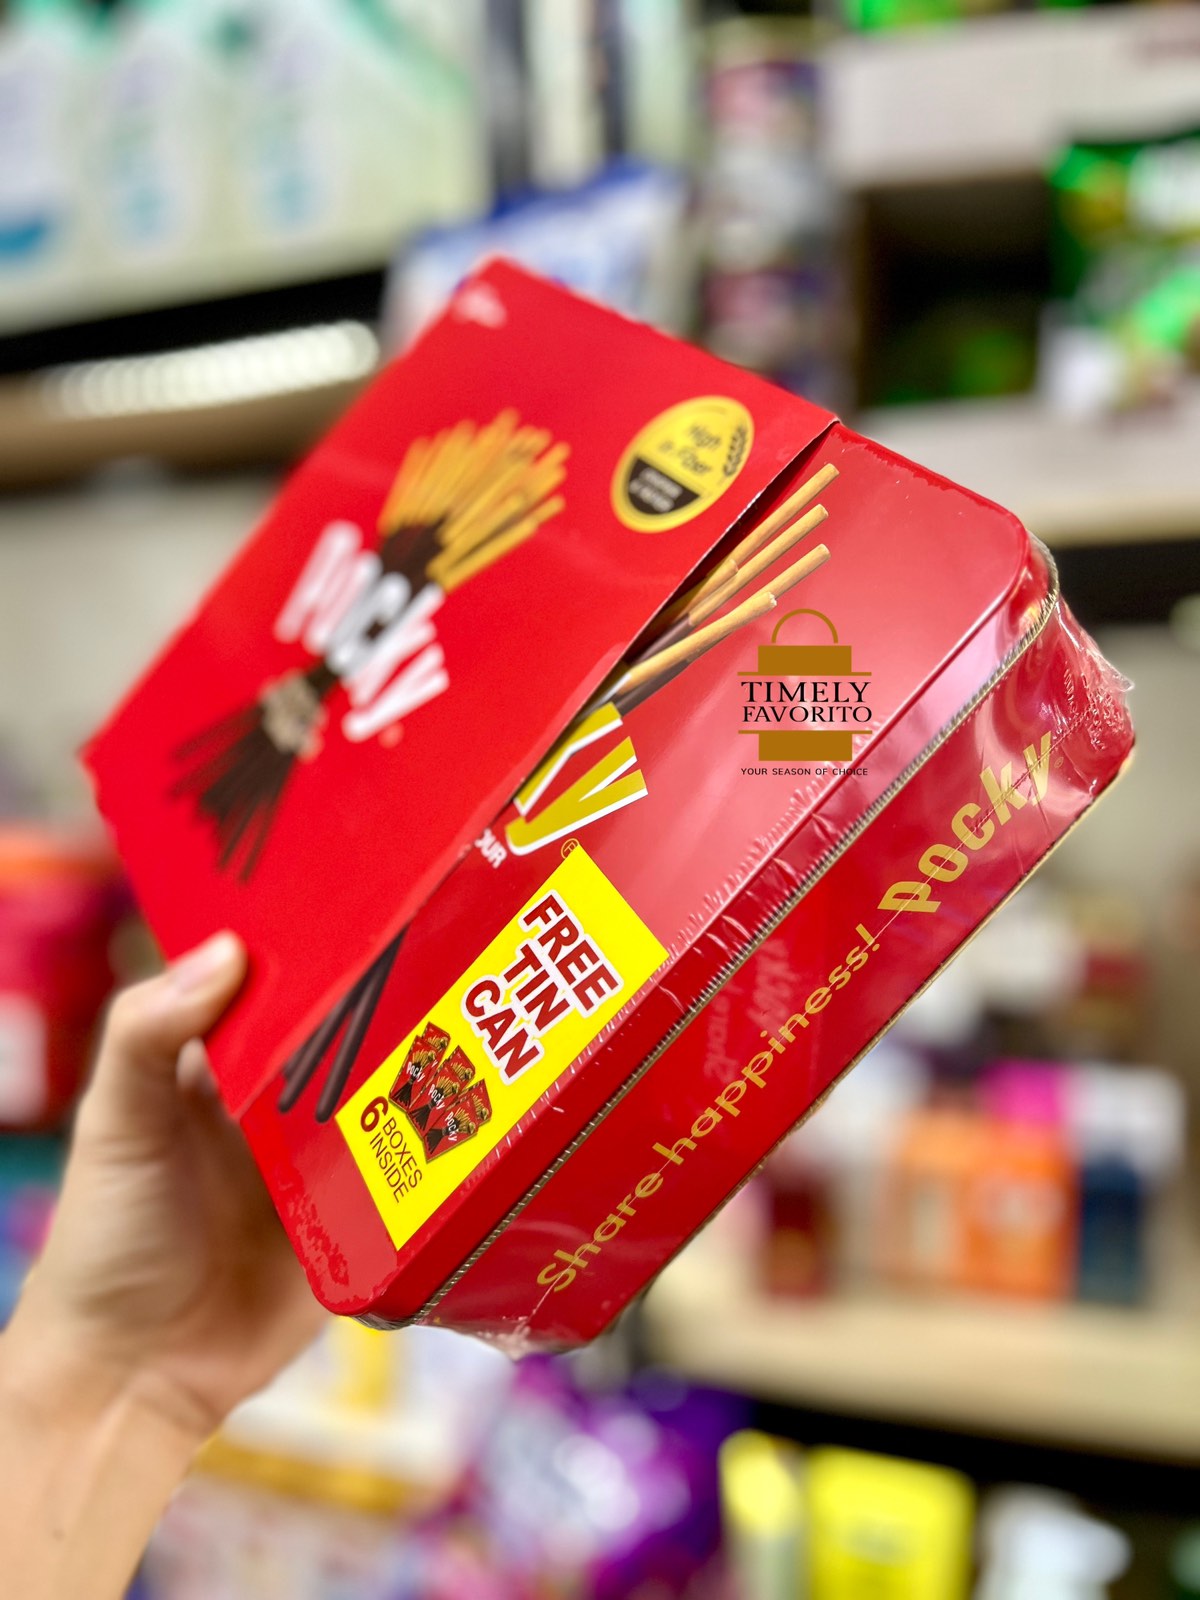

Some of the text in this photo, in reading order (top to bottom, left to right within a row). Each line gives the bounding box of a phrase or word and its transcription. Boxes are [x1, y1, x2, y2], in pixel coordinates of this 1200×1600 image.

[503, 943, 571, 1032] TIN
[522, 894, 620, 1012] FREE
[465, 979, 541, 1079] CAN
[360, 1096, 389, 1132] 6
[382, 1116, 423, 1188] BOXES
[536, 923, 881, 1293] Share happiness!
[369, 1131, 409, 1204] INSIDE
